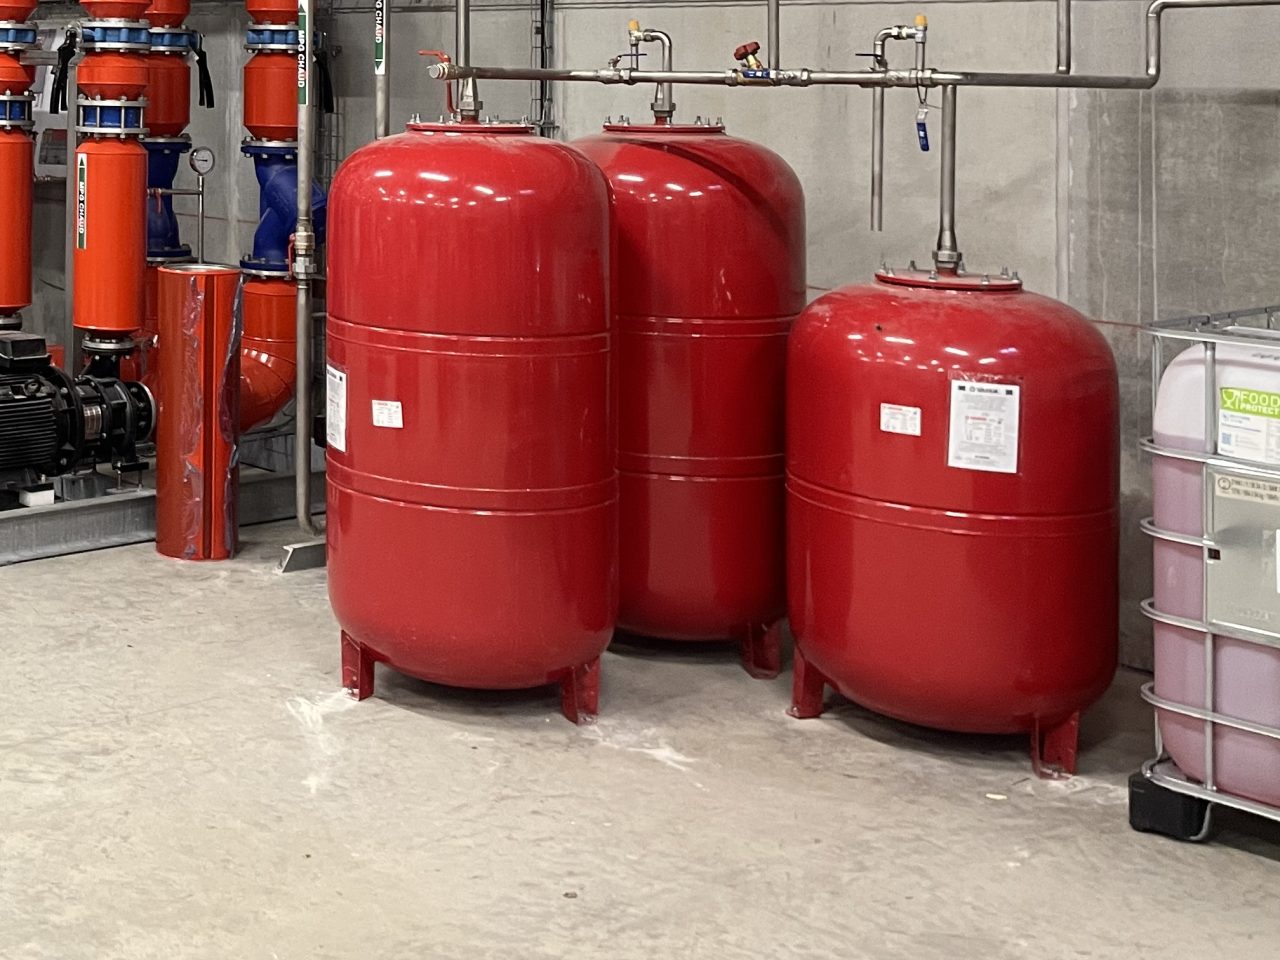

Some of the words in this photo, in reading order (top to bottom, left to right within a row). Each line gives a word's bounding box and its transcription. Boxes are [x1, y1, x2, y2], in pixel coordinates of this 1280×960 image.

[375, 10, 383, 44] CHAUD
[298, 53, 306, 88] CHAUD
[1240, 391, 1280, 408] FOOD
